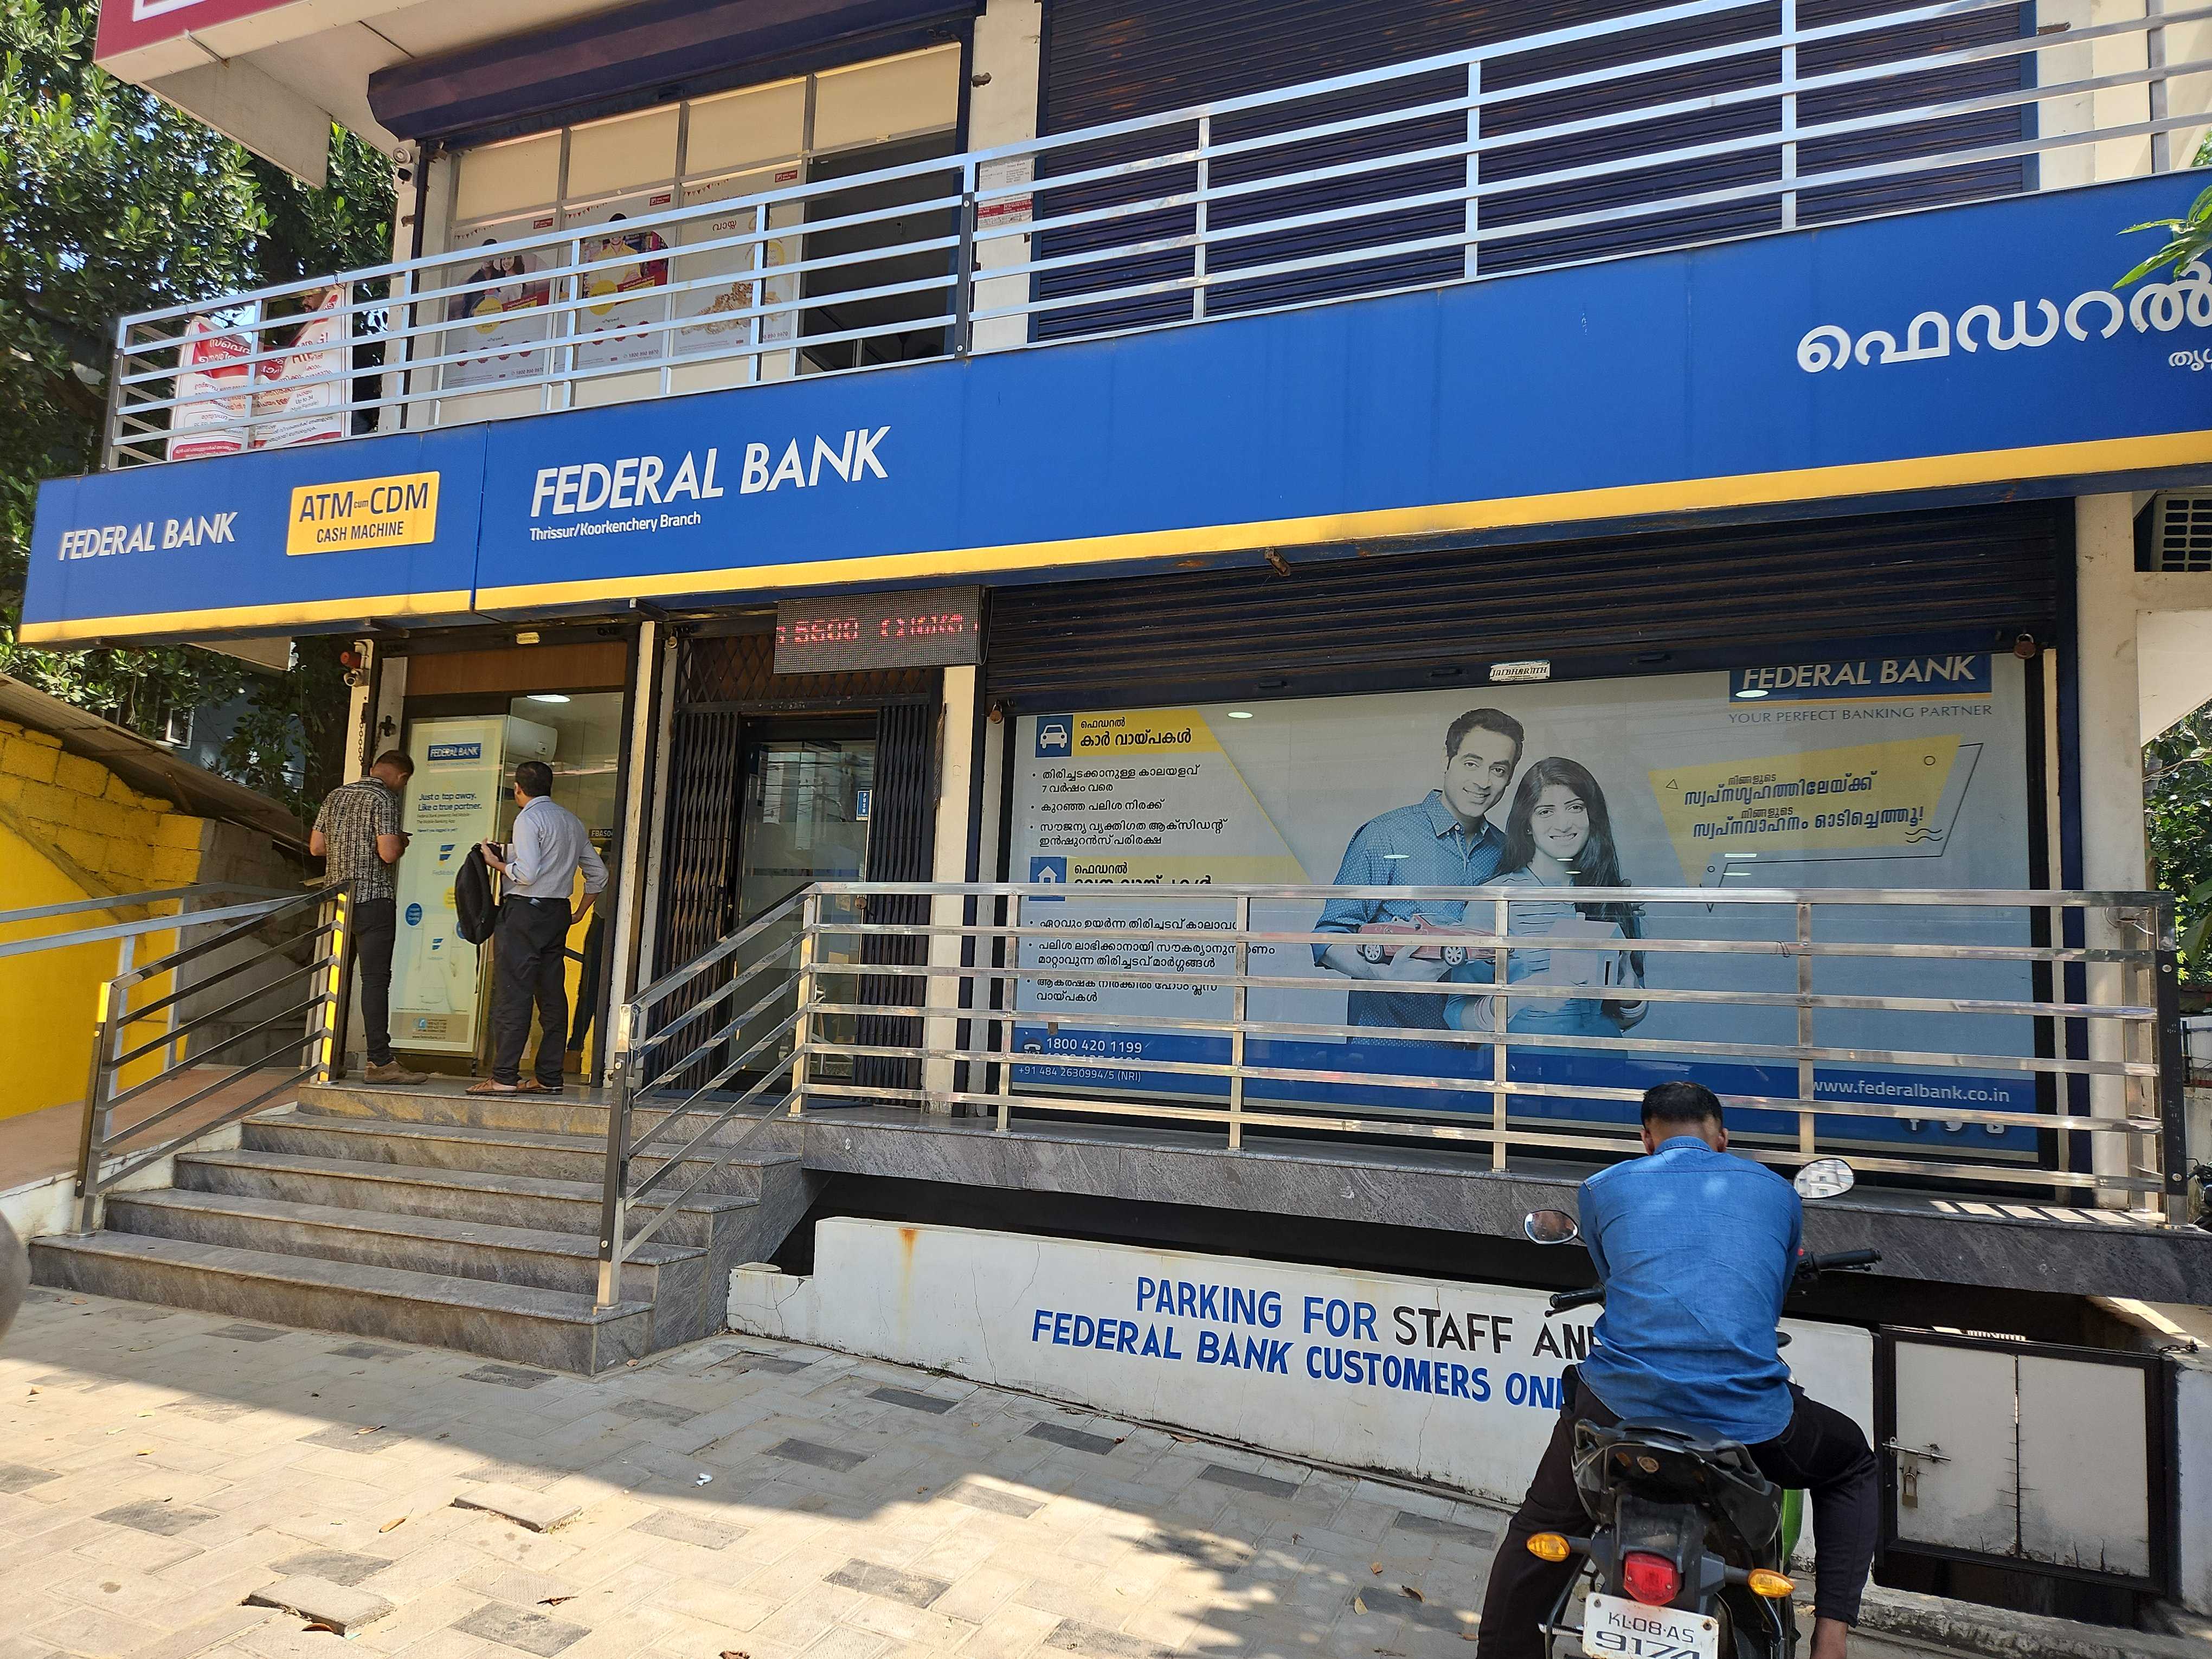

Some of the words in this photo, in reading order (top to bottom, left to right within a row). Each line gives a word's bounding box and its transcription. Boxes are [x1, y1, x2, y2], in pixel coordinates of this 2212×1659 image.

[1797, 261, 2212, 373] ഫെഡറൽ
[530, 448, 723, 517] FEDERAL
[741, 426, 891, 494] BANK
[299, 491, 353, 522] ATM
[354, 500, 369, 509] cum
[370, 483, 428, 515] CDM
[317, 526, 347, 543] CASH
[351, 521, 403, 540] MACHINE
[530, 517, 658, 541] Thrissur/Koorkenchery
[660, 511, 701, 529] Branch
[60, 523, 155, 561] FEDERAL
[163, 512, 237, 549] BANK
[1742, 661, 1872, 690] FEDERAL
[1880, 655, 1976, 684] BANK
[1081, 716, 1126, 729] ഫെഡറൽ
[1729, 713, 1773, 724] YOUR
[1777, 710, 1837, 722] PERFECT
[1843, 707, 1914, 720] BANKING
[1921, 705, 1992, 717] PARTNER
[1080, 731, 1110, 747] കാർ
[1115, 728, 1192, 745] വായ്പകൾ
[1138, 764, 1201, 778] കാലയളവ്
[1041, 785, 1047, 793] 7
[1049, 783, 1085, 793] വർഷം
[1088, 783, 1114, 792] വരെ
[1041, 802, 1085, 813] കുറഞ്ഞ
[1088, 800, 1123, 811] പലിശ
[1124, 798, 1165, 810] നിരക്ക്
[1114, 834, 1162, 845] പരിരക്ഷ
[1075, 861, 1128, 874] ഫെഡറൽ
[1039, 939, 1072, 950] പലിശ
[1036, 991, 1098, 1002] വായ്പകൾ
[1047, 1038, 1078, 1050] 1800
[1081, 1039, 1105, 1052] 420
[1110, 1041, 1142, 1053] 1199
[1019, 1066, 1036, 1075] +91
[1039, 1067, 1057, 1076] 484
[1060, 1068, 1114, 1079] 2630994/5
[1117, 1071, 1141, 1083] (NRI)
[1814, 1080, 2010, 1103] www.federalbank.co.in
[1136, 1276, 1282, 1329] PARKING
[1302, 1296, 1378, 1343] FOR
[1392, 1305, 1513, 1355] STAFF
[1031, 1309, 1183, 1361] FEDERAL
[1196, 1330, 1296, 1376] BANK
[1304, 1345, 1491, 1403] CUSTOMERS
